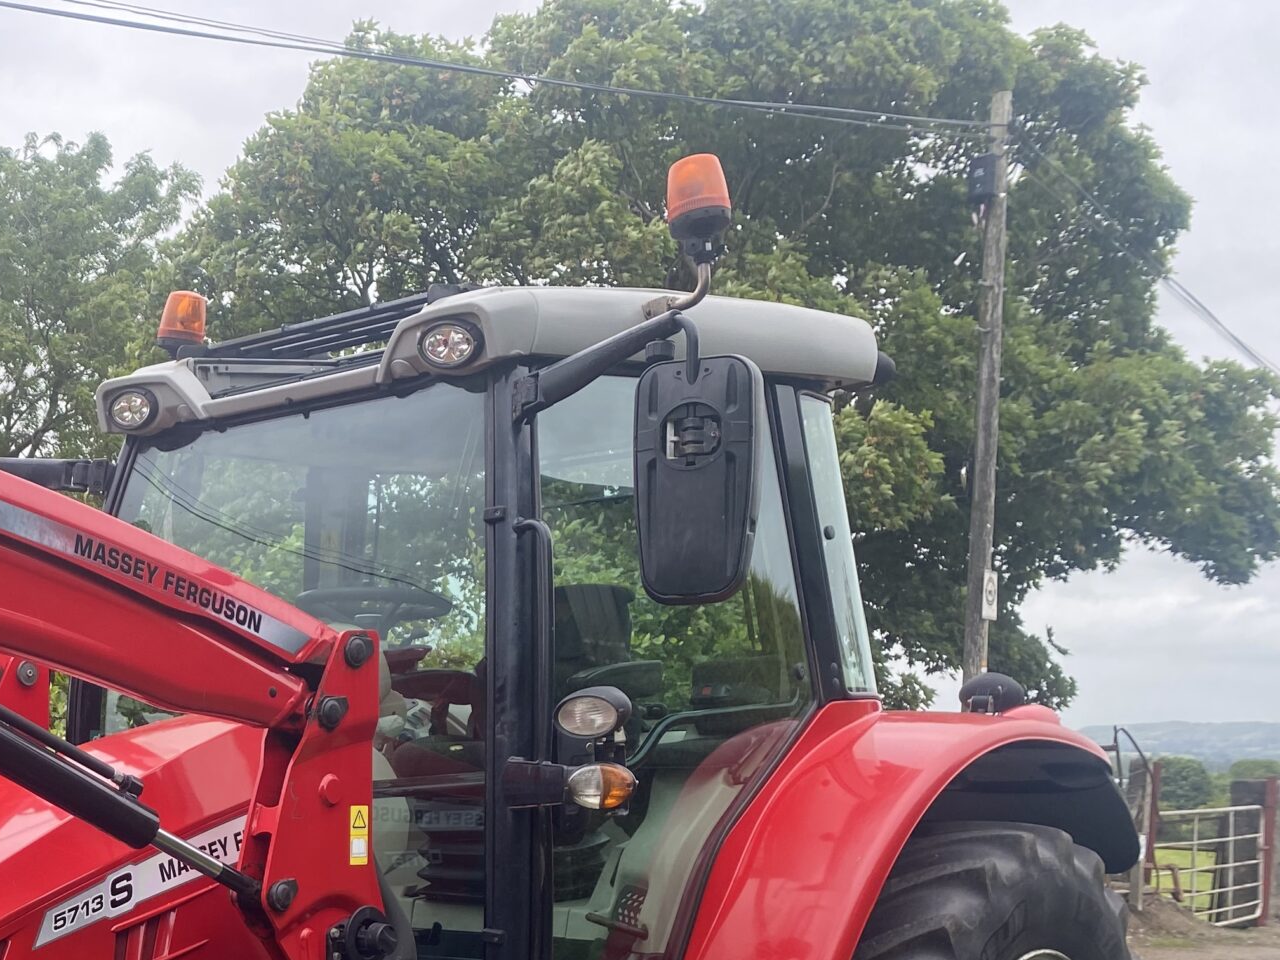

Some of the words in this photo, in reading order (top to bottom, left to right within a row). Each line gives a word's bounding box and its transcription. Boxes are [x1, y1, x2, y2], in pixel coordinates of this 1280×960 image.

[73, 533, 159, 585] MASSEY
[163, 571, 263, 634] FERGUSON
[53, 893, 105, 933] 5713
[110, 872, 133, 909] S
[158, 836, 228, 883] MAEY
